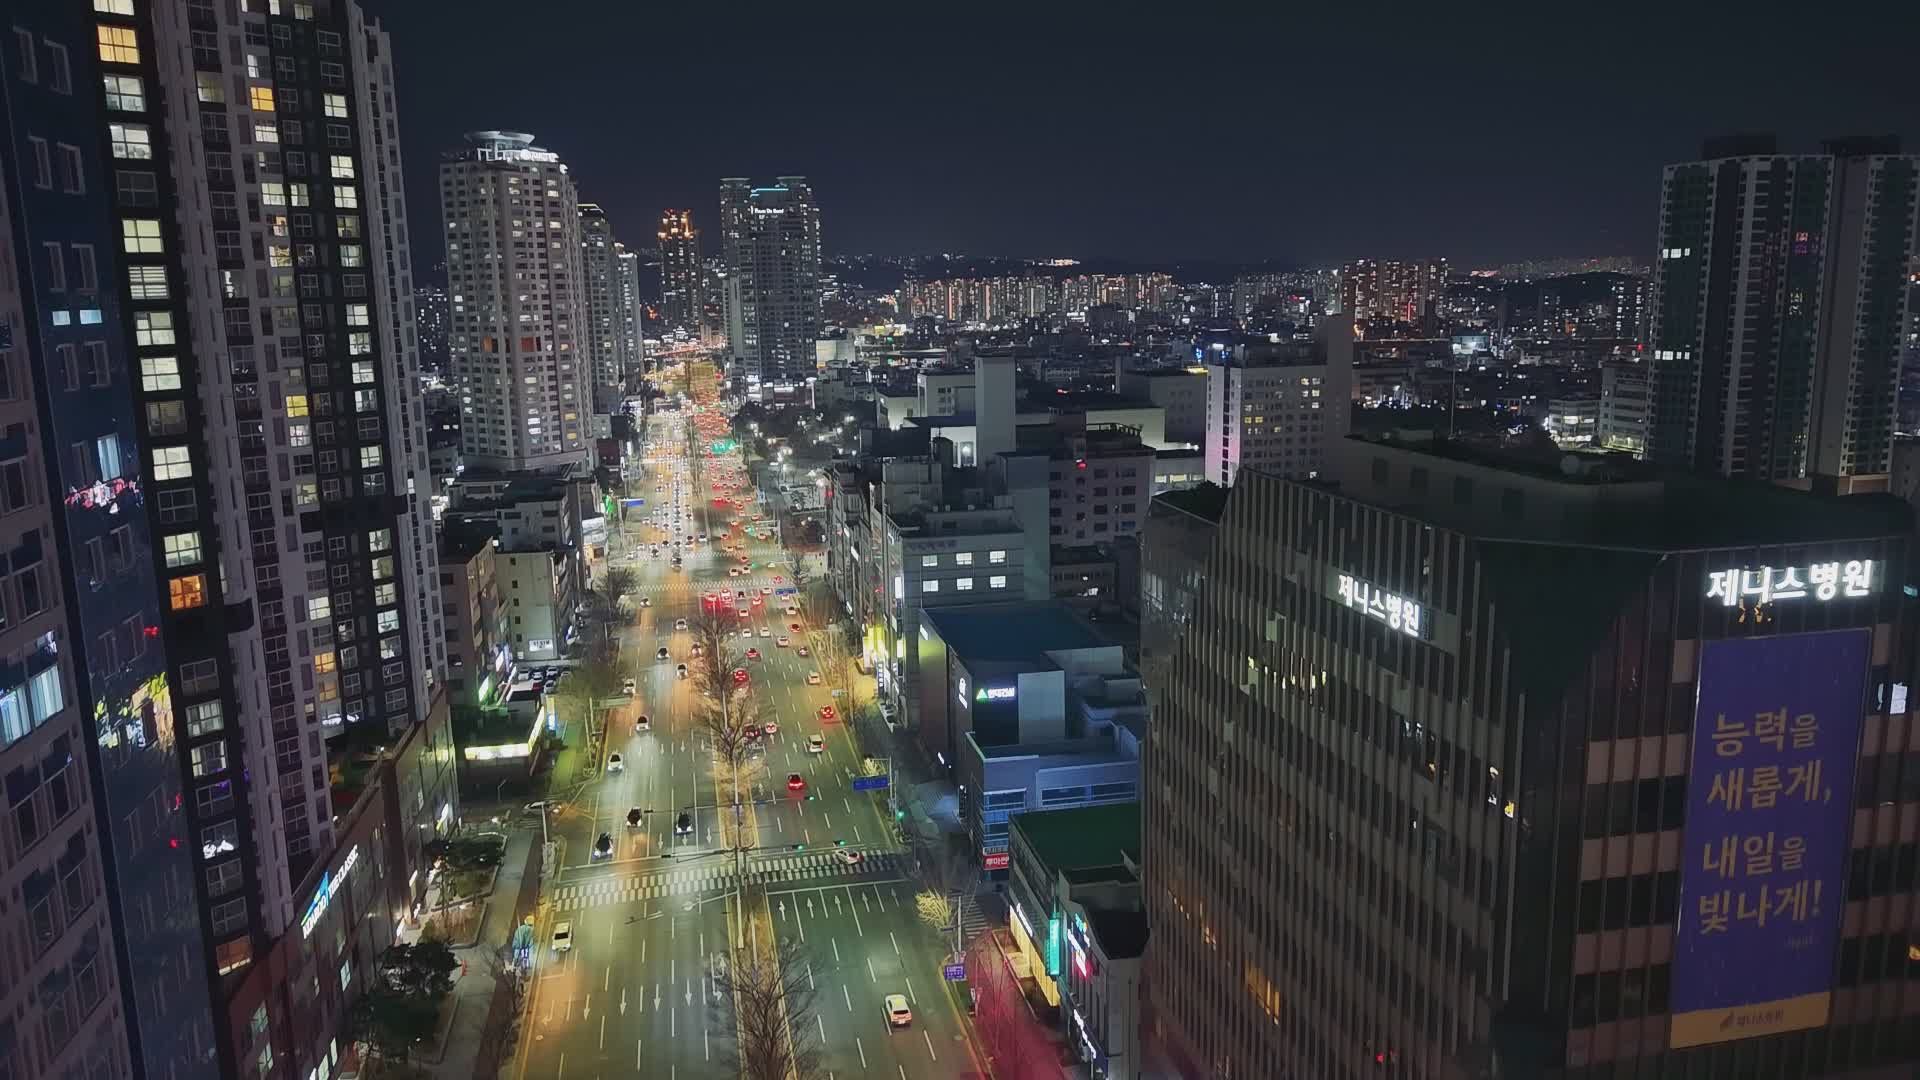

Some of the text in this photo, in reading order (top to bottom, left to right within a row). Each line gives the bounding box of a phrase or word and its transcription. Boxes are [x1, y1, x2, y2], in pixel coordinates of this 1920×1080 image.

[1338, 574, 1420, 638] 제니스병원
[1707, 560, 1873, 607] 제니스병원
[1711, 708, 1818, 757] 능력을
[1706, 759, 1832, 811] 새롭게,
[1702, 832, 1806, 880] 내일을
[1699, 879, 1822, 935] 빛나게!
